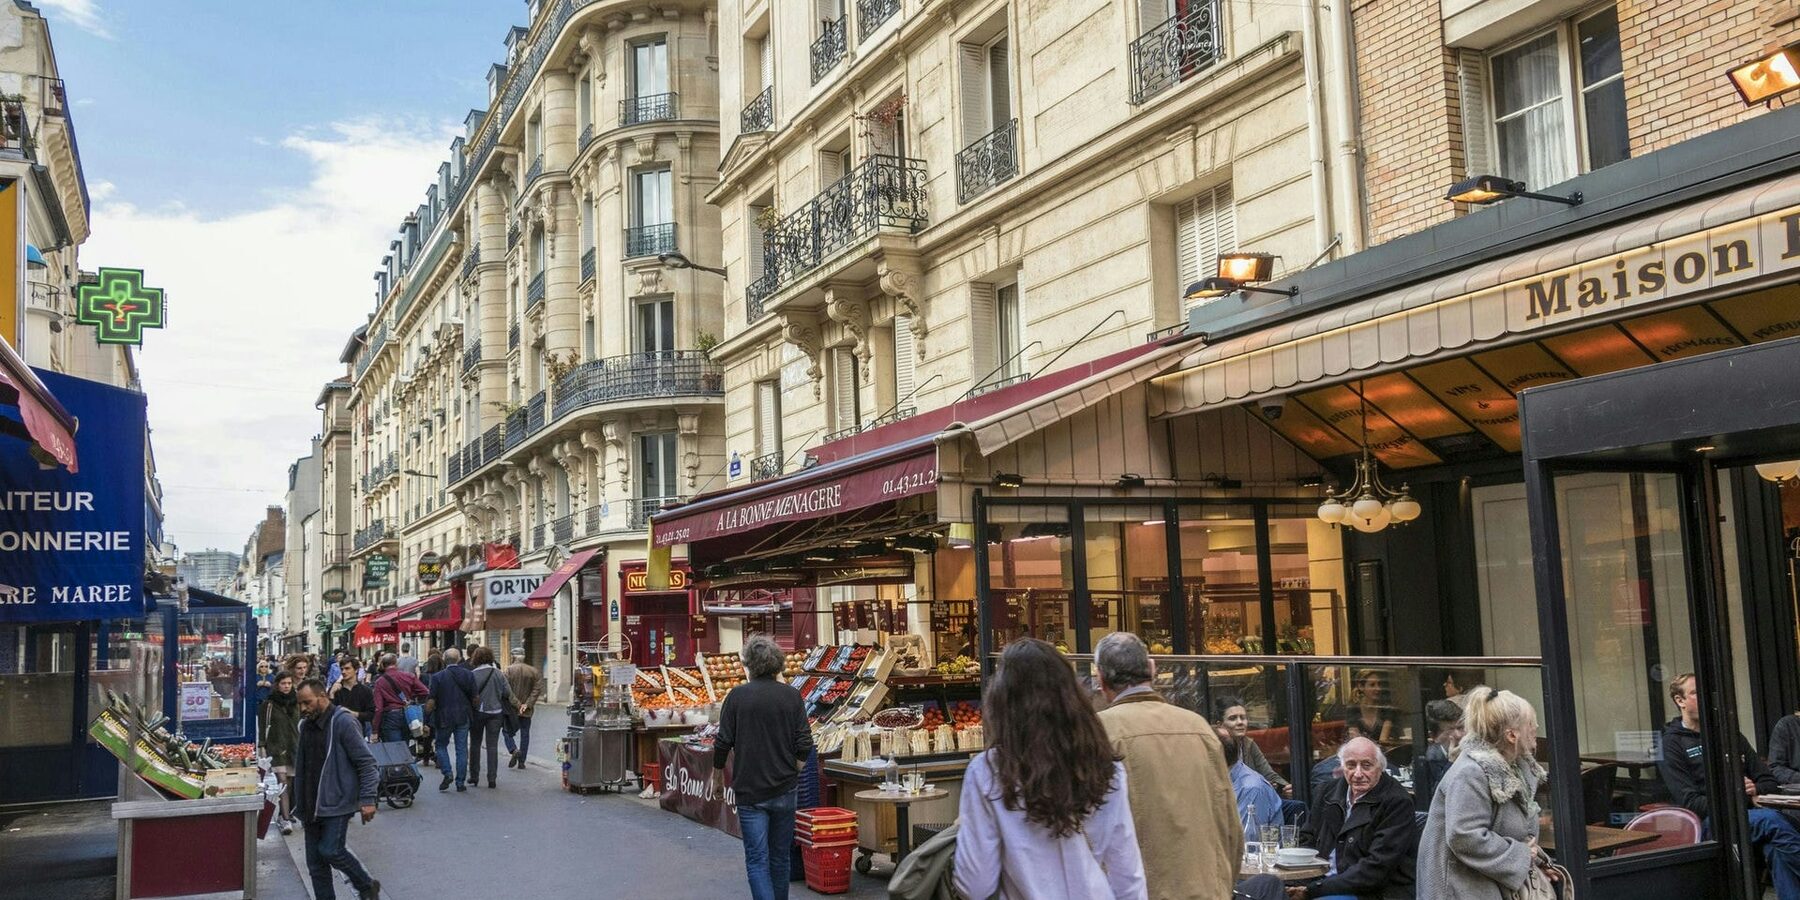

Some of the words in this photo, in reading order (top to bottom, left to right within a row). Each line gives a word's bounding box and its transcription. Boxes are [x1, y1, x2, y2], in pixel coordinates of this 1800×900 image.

[1525, 239, 1753, 321] Maison
[1446, 384, 1482, 396] VINS
[716, 512, 724, 531] A
[725, 509, 738, 530] LA
[739, 500, 775, 527] BONNE
[772, 484, 842, 518] MENAGERE
[0, 586, 37, 605] RE
[51, 584, 132, 604] MAREE
